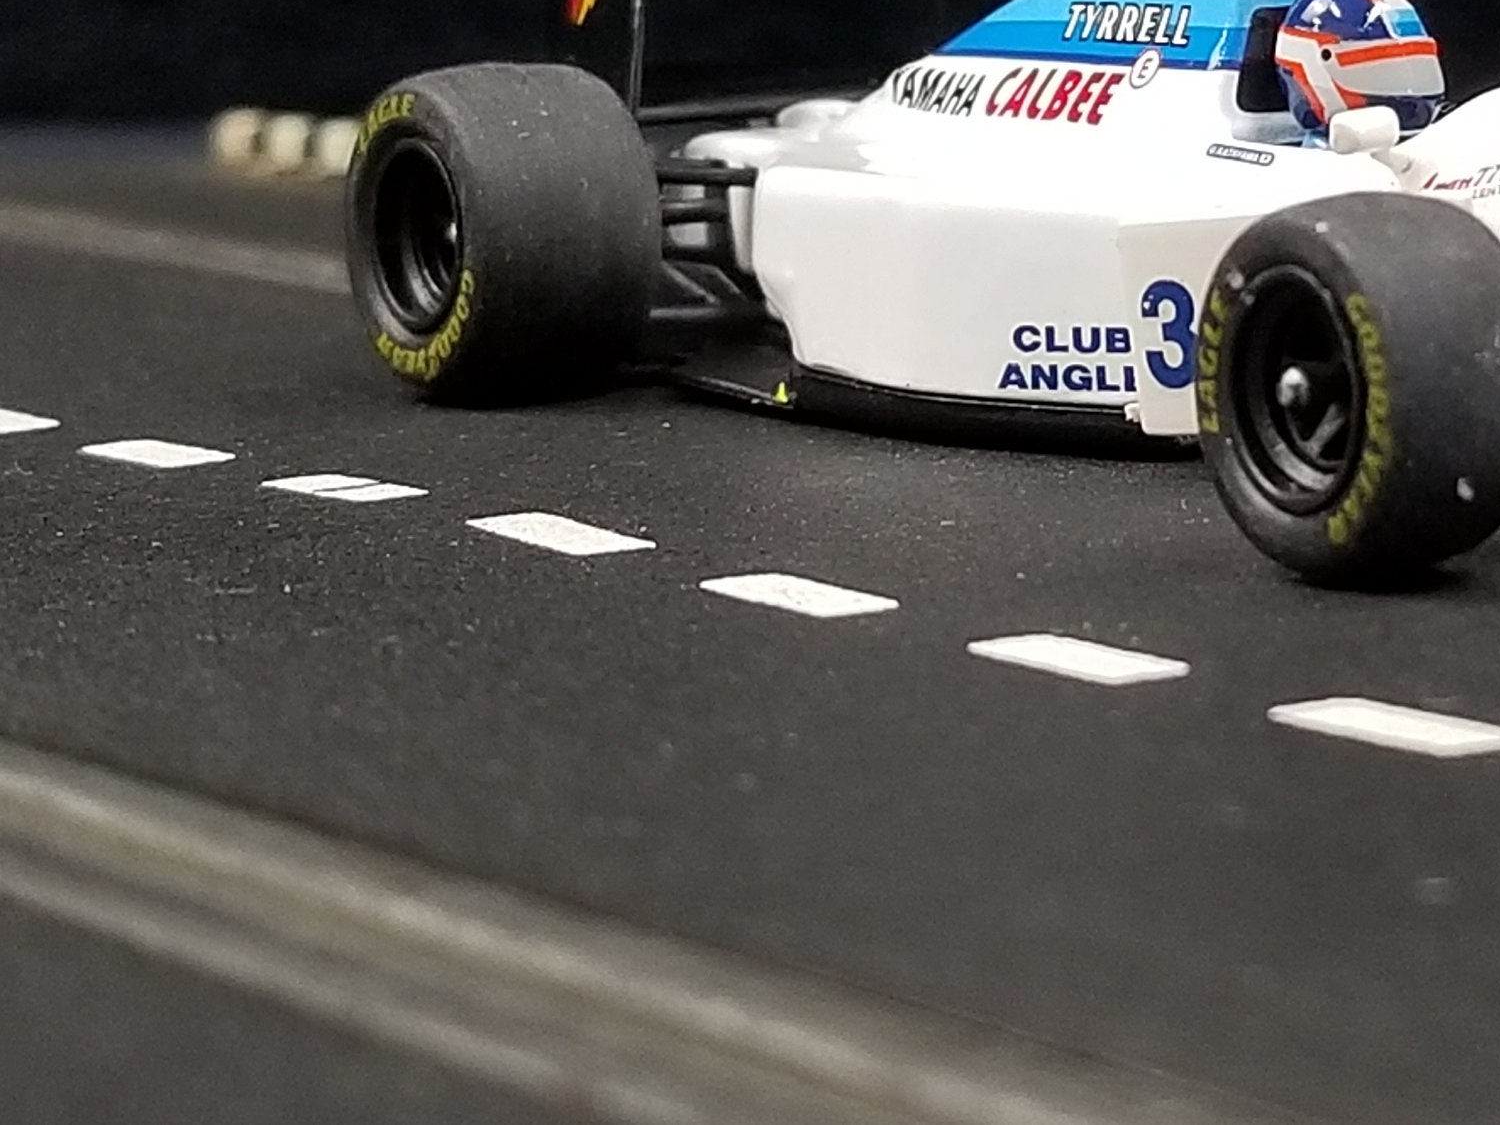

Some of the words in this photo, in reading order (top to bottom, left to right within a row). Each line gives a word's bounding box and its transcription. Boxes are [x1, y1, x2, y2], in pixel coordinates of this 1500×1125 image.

[1061, 2, 1191, 48] TYRRELL
[984, 66, 1126, 126] CALBEE
[1012, 324, 1132, 354] CLUB
[1141, 279, 1199, 389] 3
